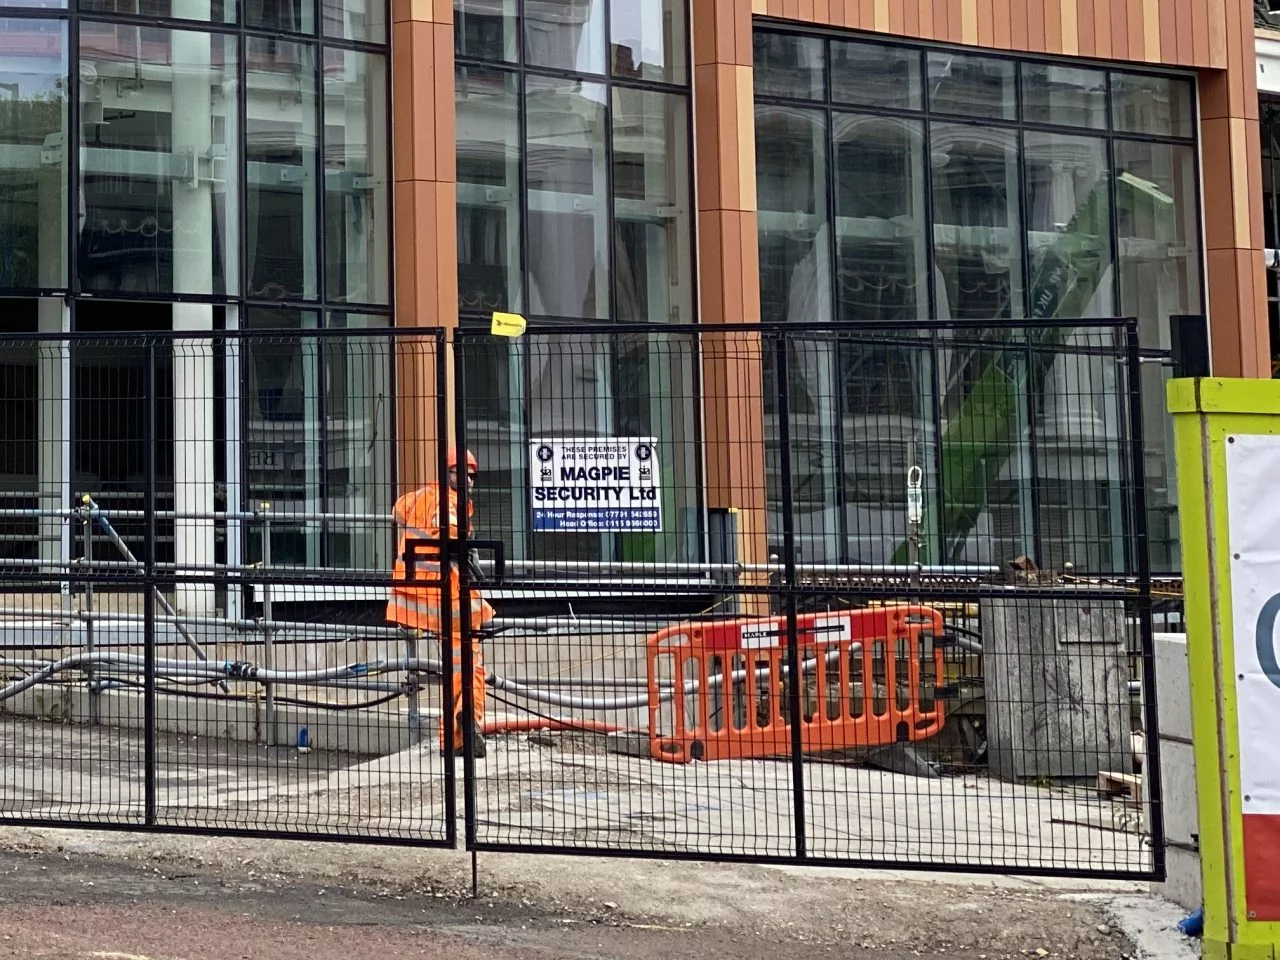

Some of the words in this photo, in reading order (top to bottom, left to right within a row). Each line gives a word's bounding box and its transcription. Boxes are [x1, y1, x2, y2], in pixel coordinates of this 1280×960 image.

[560, 466, 630, 481] MAGPIE
[535, 486, 624, 501] SECURITY
[630, 485, 657, 501] Ltd
[547, 511, 565, 519] Hour
[560, 520, 578, 528] Head
